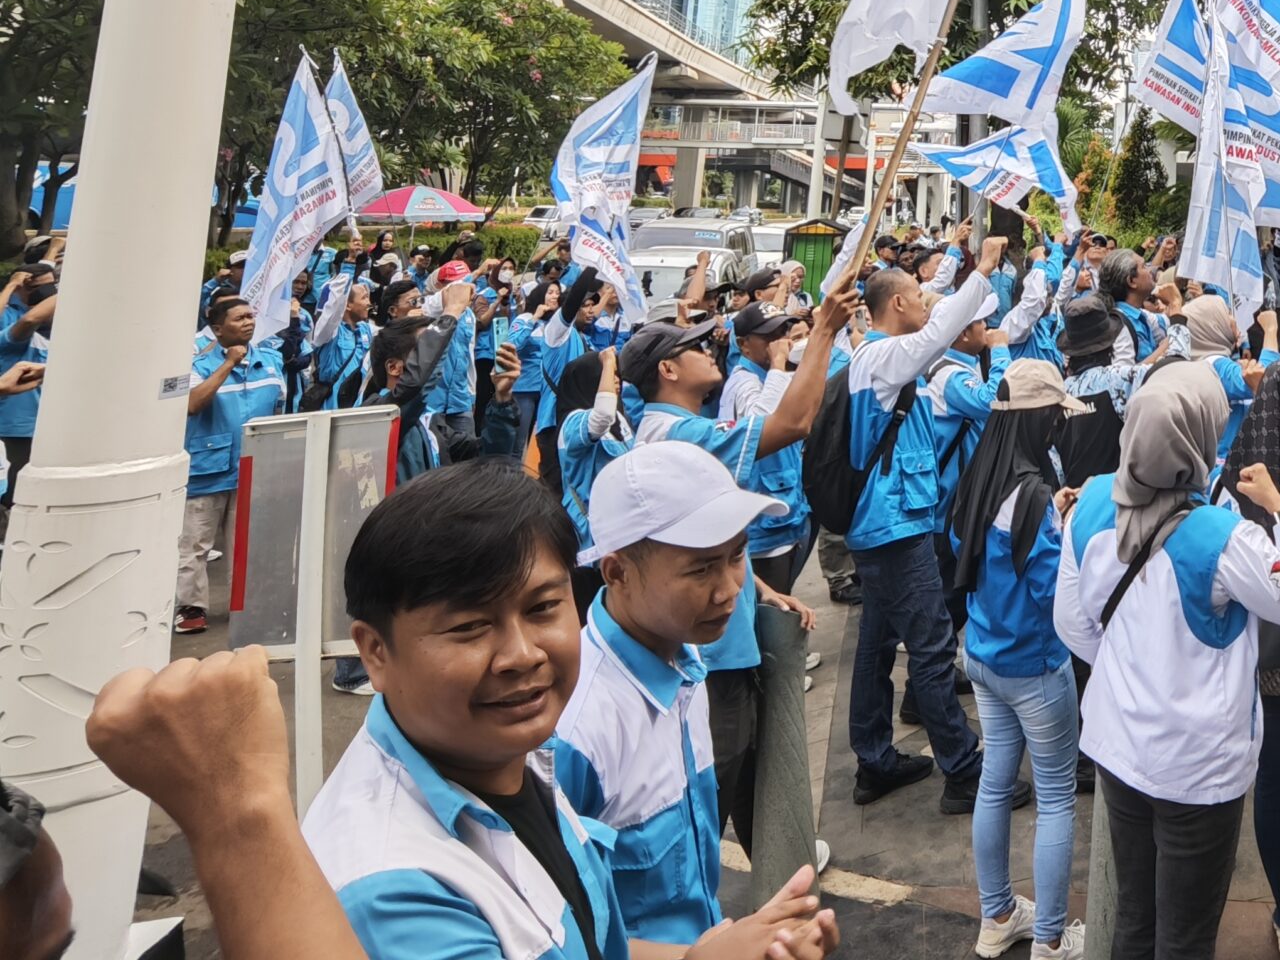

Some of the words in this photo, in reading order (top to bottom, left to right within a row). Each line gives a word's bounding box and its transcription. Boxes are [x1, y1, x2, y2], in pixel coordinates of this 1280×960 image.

[1143, 77, 1183, 106] KAWASAN
[1181, 101, 1201, 119] INDU
[1148, 67, 1178, 90] PIMPINAN
[1176, 84, 1199, 105] SERIKAT
